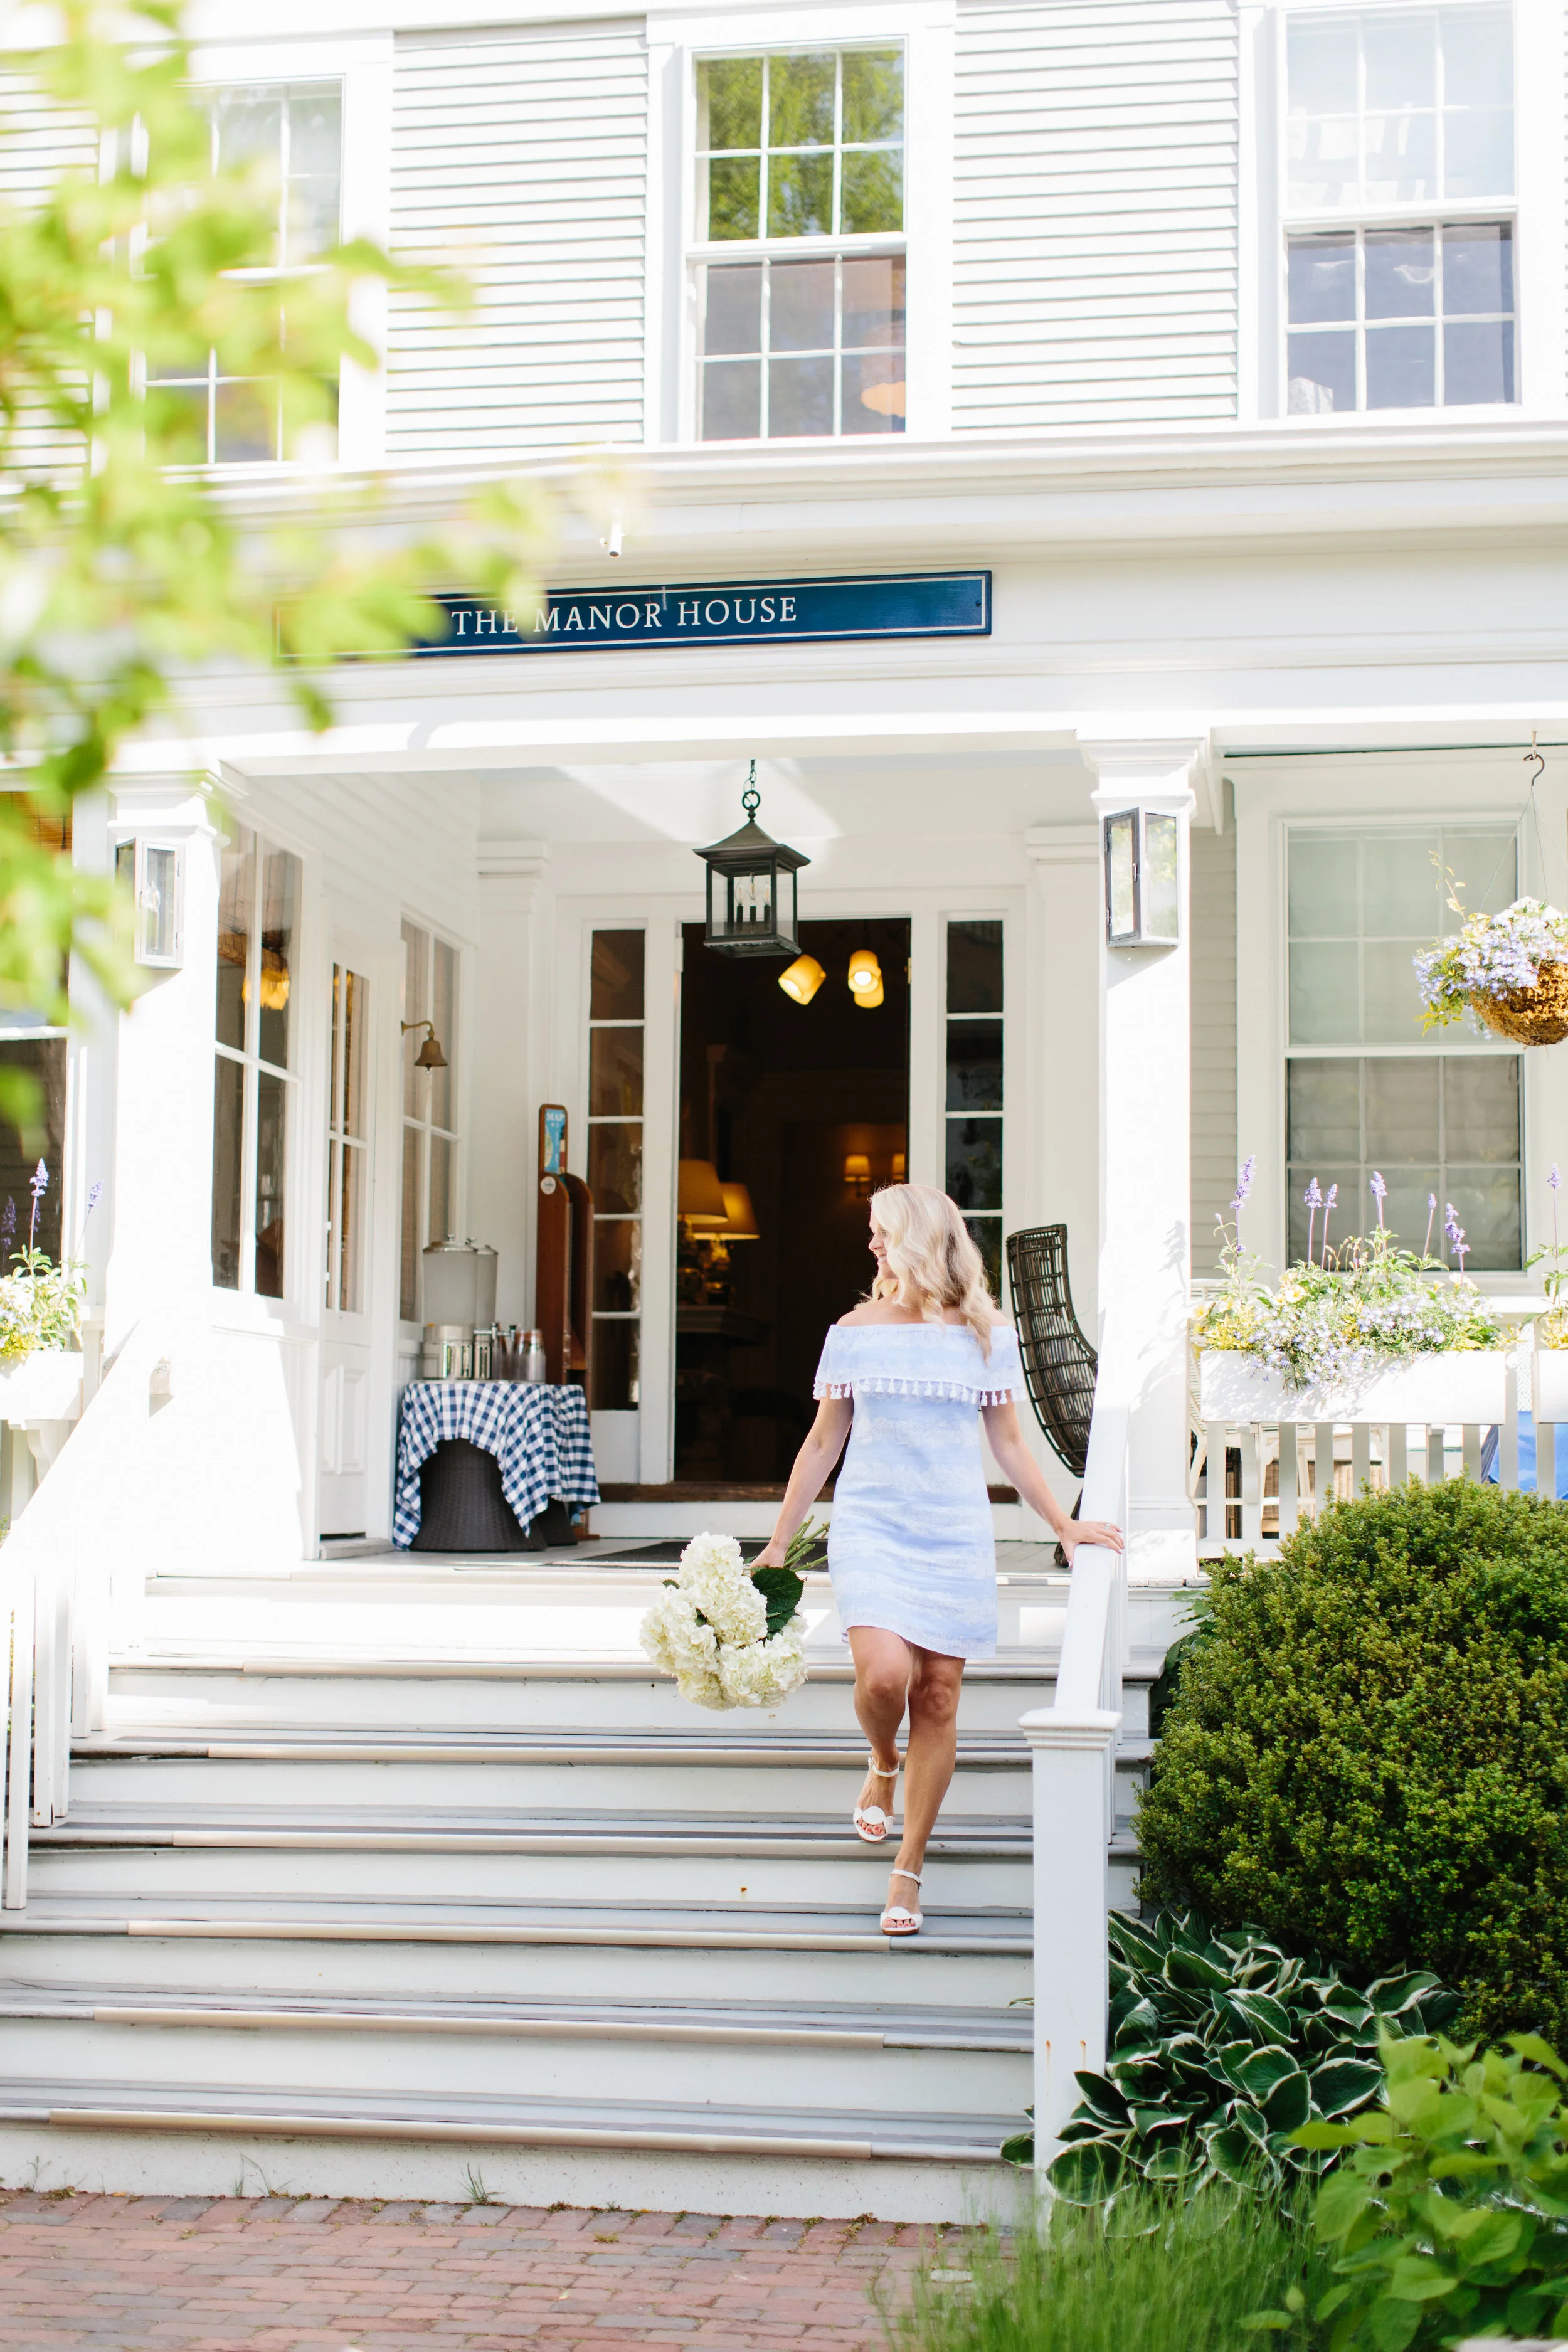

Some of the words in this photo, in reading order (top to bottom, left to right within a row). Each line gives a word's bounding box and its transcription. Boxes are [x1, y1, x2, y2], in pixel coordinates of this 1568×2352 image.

[451, 609, 519, 635] THE
[533, 603, 662, 633] MANOR
[677, 596, 797, 627] HOUSE
